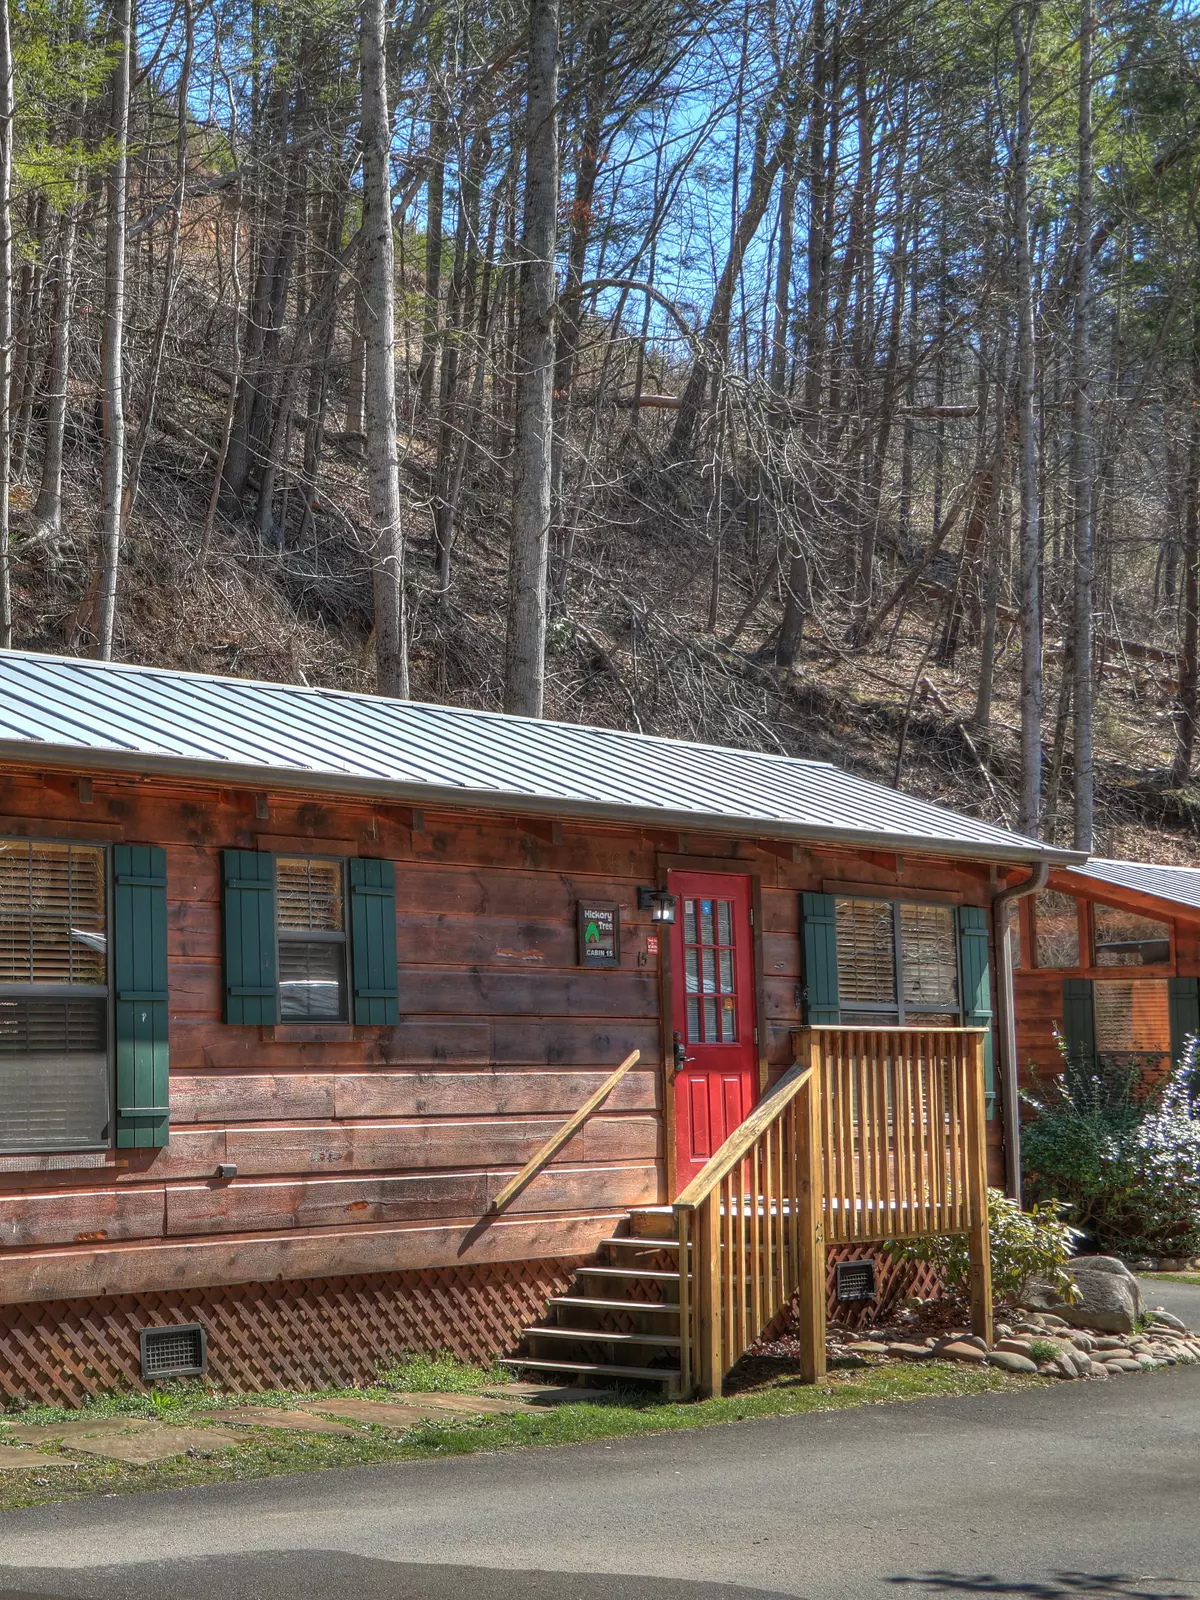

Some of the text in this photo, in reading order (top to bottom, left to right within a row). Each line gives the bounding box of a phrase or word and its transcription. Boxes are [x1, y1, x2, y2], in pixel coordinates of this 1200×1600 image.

[584, 910, 612, 921] Hickory
[598, 922, 613, 930] Tree
[638, 952, 647, 967] 15
